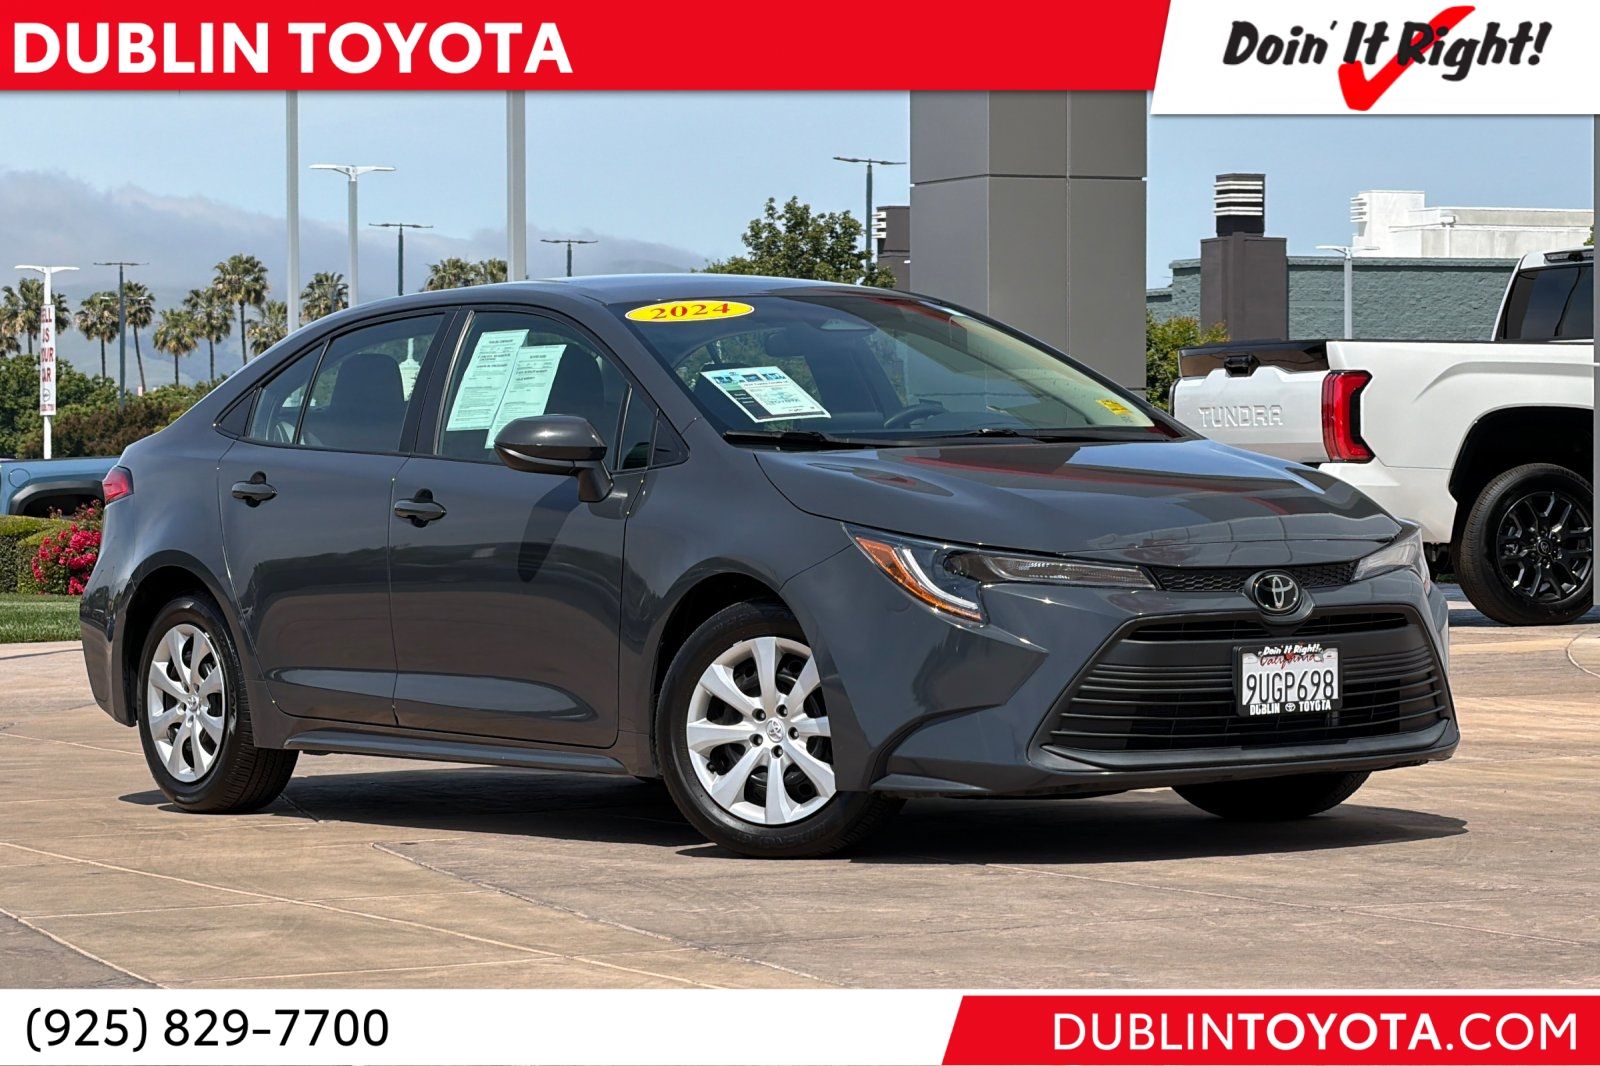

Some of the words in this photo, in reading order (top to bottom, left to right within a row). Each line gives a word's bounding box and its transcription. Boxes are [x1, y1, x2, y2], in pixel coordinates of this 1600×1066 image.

[650, 303, 730, 320] 2024
[1198, 405, 1283, 427] TUNDRA
[1284, 645, 1293, 654] It
[1294, 643, 1321, 656] Right!
[1246, 670, 1334, 705] 9UGP698
[1250, 703, 1280, 716] DUBLIN
[1299, 700, 1332, 712] TOYOTA
